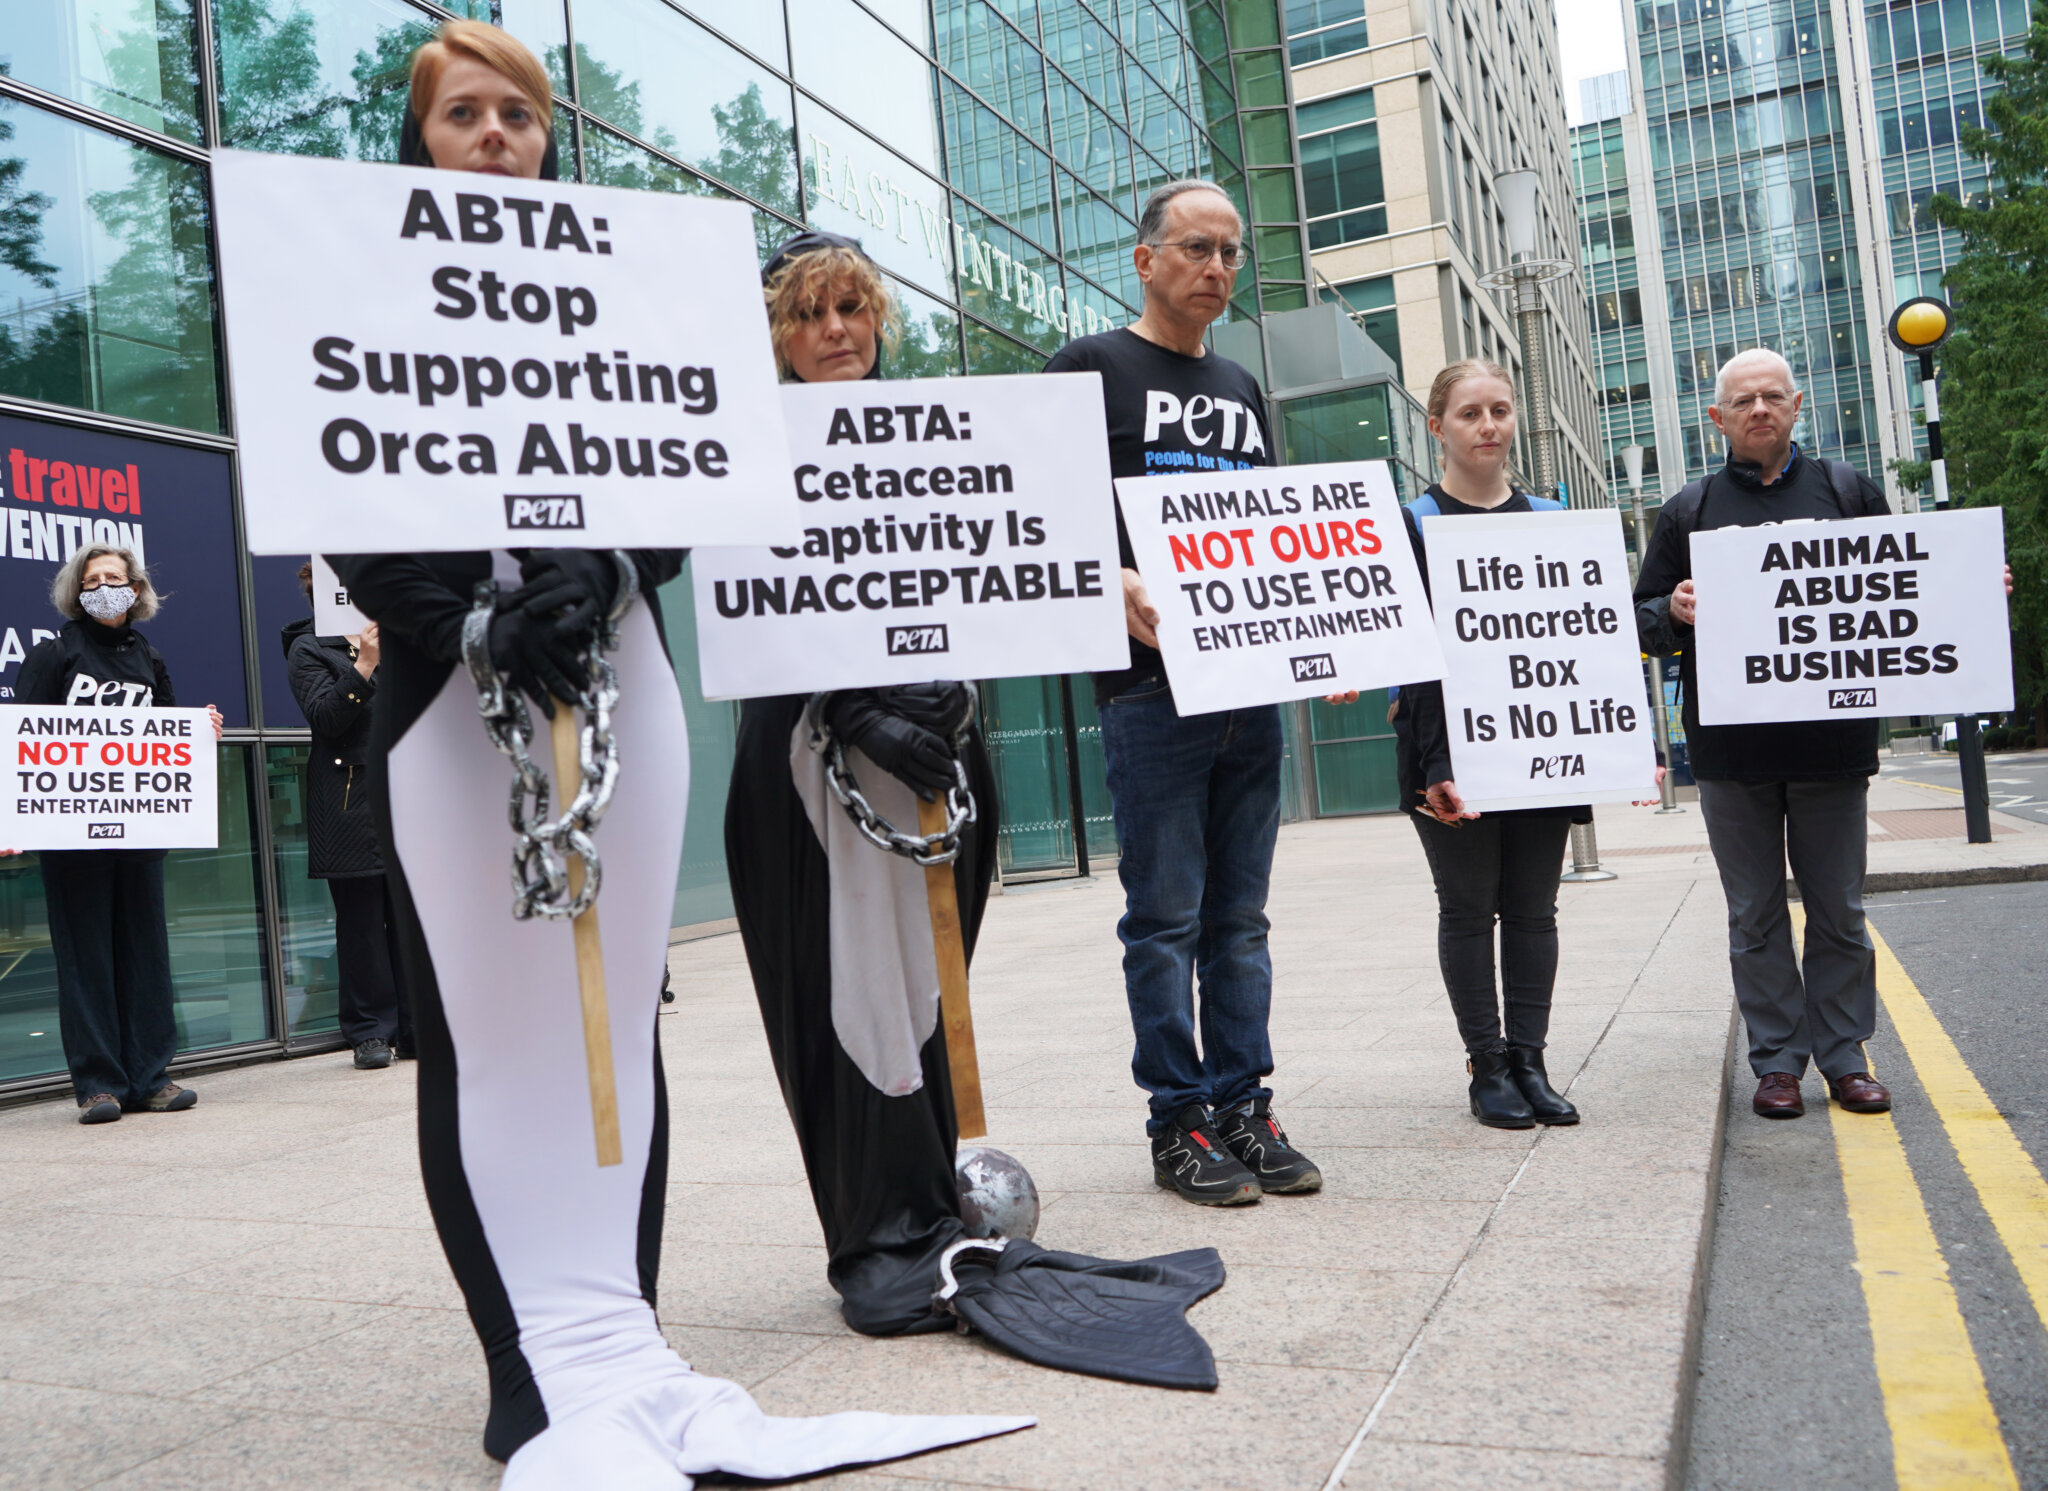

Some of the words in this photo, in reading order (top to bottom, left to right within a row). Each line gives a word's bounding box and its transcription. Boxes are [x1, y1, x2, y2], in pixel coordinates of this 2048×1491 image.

[401, 189, 611, 254] ABTA:
[809, 134, 909, 244] EAST
[915, 200, 1120, 338] WINTERGAR
[432, 266, 597, 335] Stop
[313, 337, 717, 415] Supporting
[827, 405, 971, 445] ABTA:
[321, 418, 497, 475] Orca
[517, 424, 728, 477] Abuse
[1145, 451, 1194, 467] People
[1197, 453, 1215, 469] for
[8, 448, 141, 515] travel
[794, 464, 1013, 502] Cetacean
[1162, 487, 1301, 523] ANIMALS
[1313, 482, 1370, 511] ARE
[770, 513, 993, 564] aptivity
[1006, 510, 1045, 546] Is
[1169, 529, 1254, 572] NOT
[1271, 519, 1382, 563] OURS
[1761, 532, 1929, 572] ANIMAL
[714, 561, 1103, 618] UNACCEPTABLE
[1181, 581, 1233, 616] TO
[1242, 572, 1316, 610] USE
[1322, 565, 1396, 601] FOR
[1457, 557, 1523, 592] Life
[1535, 555, 1569, 588] in
[1583, 560, 1602, 586] a
[1775, 570, 1918, 608] ABUSE
[1193, 604, 1403, 652] ENTERTAINMENT
[1456, 602, 1617, 642] Concrete
[1779, 615, 1817, 645] IS
[1829, 609, 1918, 642] BAD
[1509, 655, 1579, 689] Box
[1745, 644, 1958, 684] BUSINESS
[18, 718, 133, 736] ANIMALS
[143, 719, 191, 736] ARE
[1464, 708, 1496, 742] Is
[1509, 704, 1557, 739] No
[1570, 698, 1636, 735] Life
[19, 742, 88, 765] NOT
[101, 742, 191, 766] OURS
[17, 772, 57, 792] TO
[69, 772, 124, 792] USE
[136, 772, 191, 792] FOR
[18, 799, 192, 813] ENTERTAINMENT
